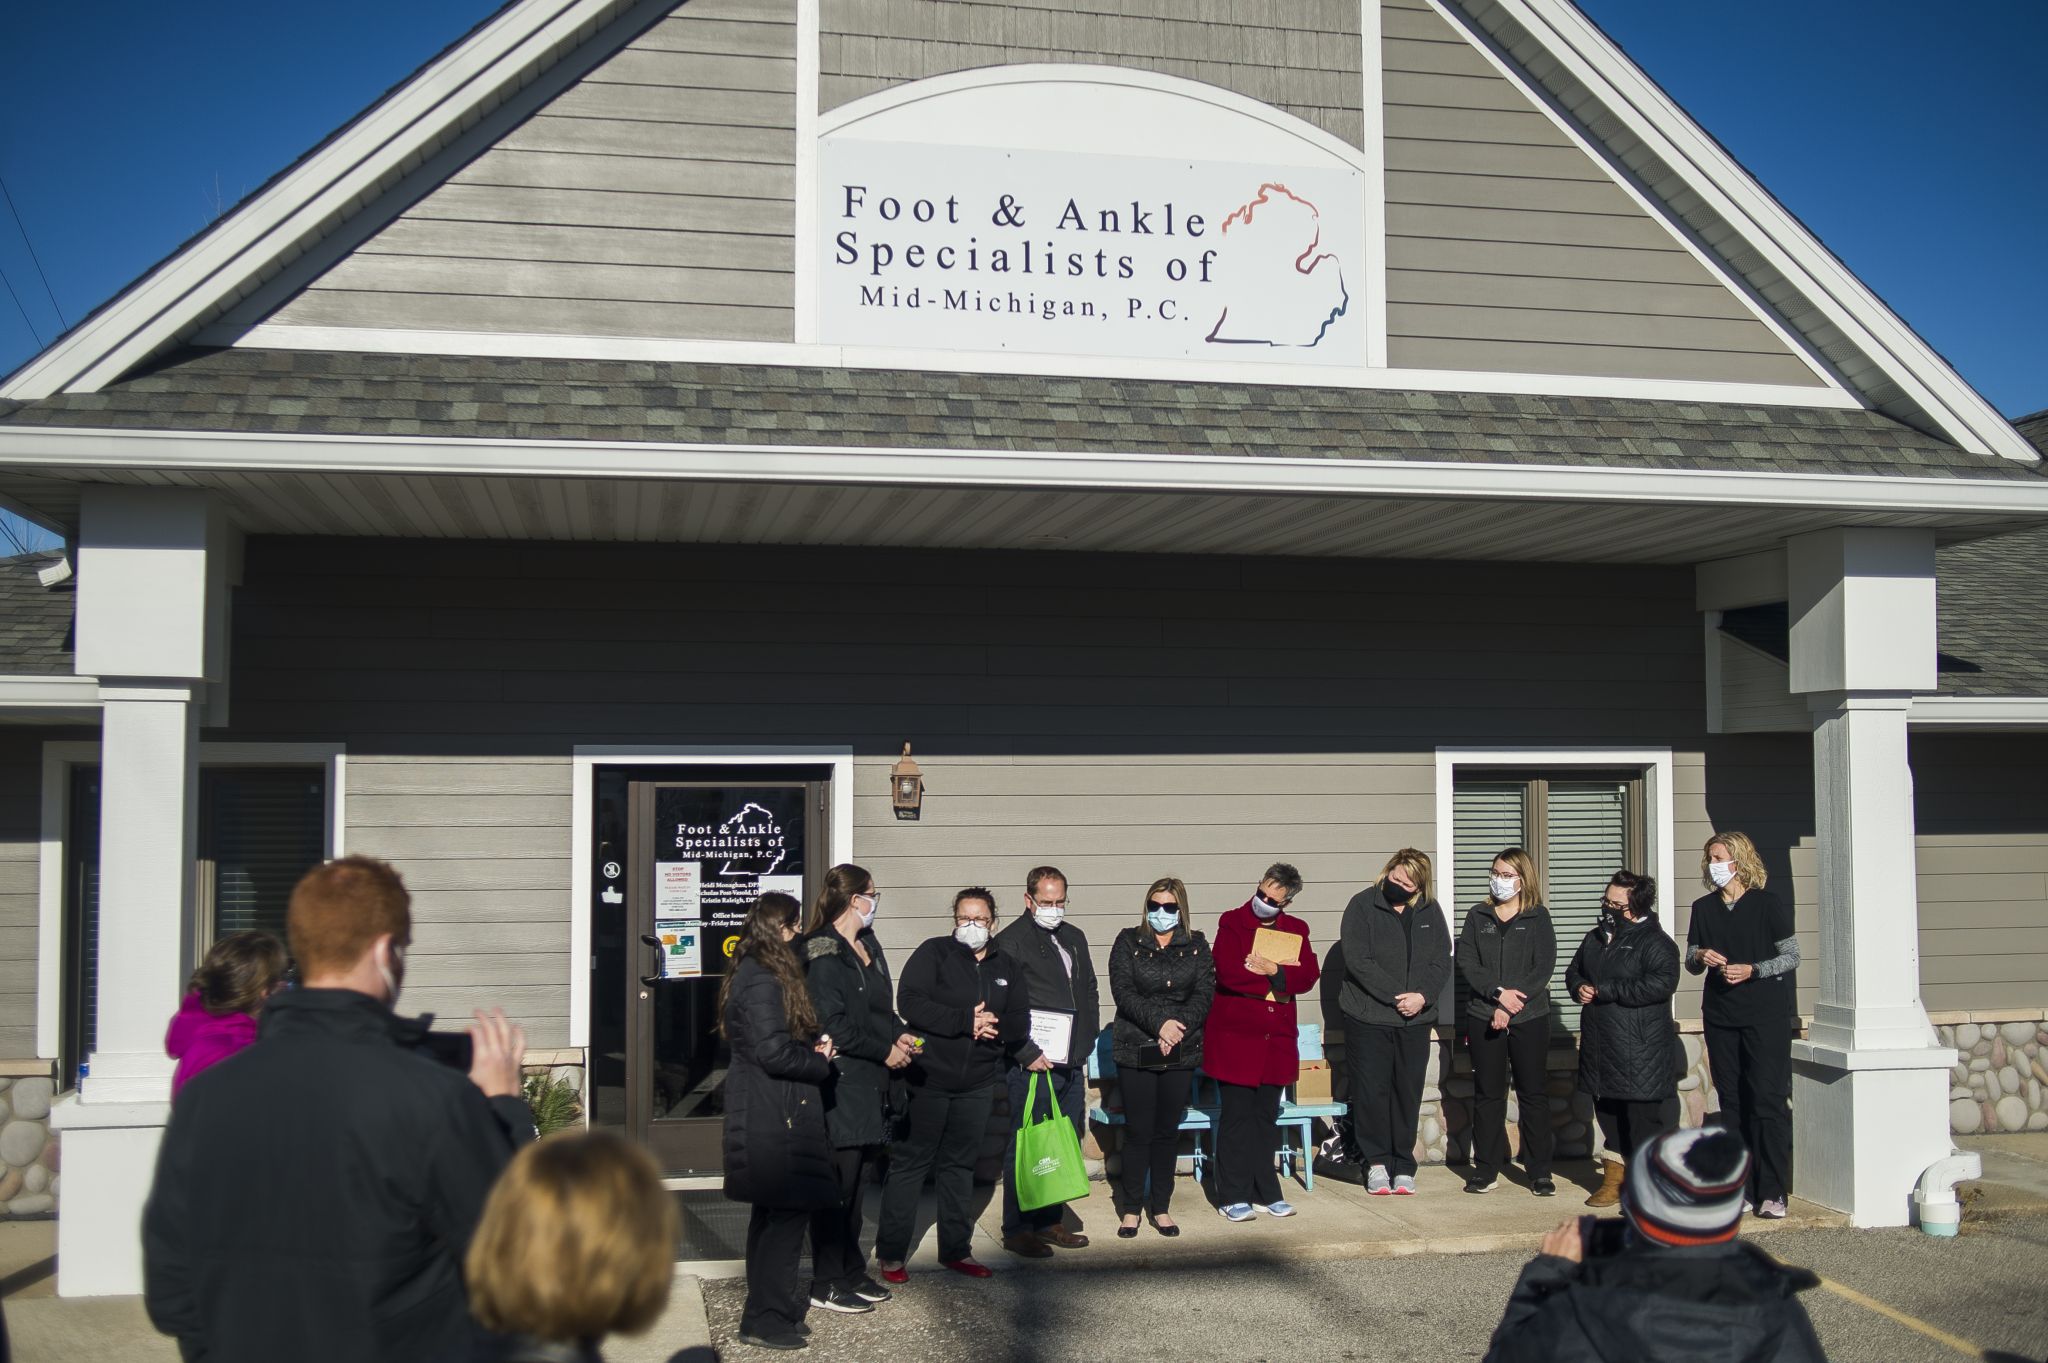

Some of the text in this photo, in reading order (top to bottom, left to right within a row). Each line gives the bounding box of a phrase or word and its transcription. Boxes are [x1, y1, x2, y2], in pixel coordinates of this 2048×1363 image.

[841, 184, 1206, 238] Foot & Ankle
[835, 231, 1218, 283] Specialists of
[859, 284, 1190, 322] Mid-Michigan, P.C.
[677, 823, 781, 835] Foot & Ankle
[675, 836, 785, 849] Specialists of
[682, 851, 776, 860] Mid-Michigan, P.C.
